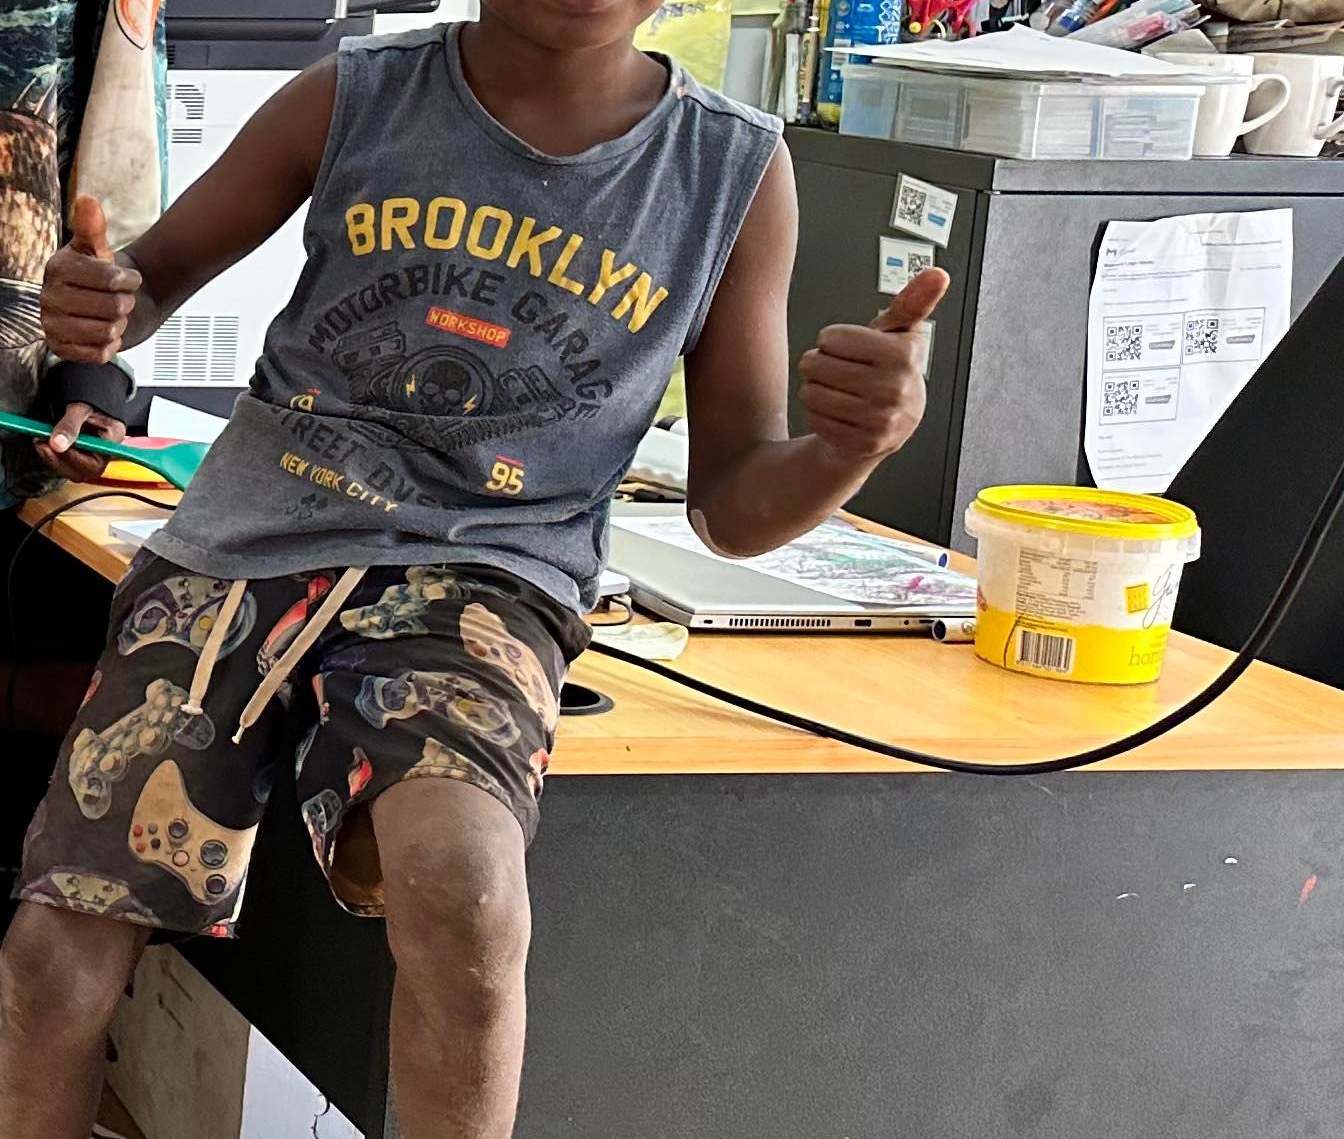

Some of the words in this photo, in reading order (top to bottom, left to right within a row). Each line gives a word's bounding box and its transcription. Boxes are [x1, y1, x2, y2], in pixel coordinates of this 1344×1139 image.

[344, 195, 669, 334] BROOKLYN
[308, 262, 506, 354] MOTORBIKE
[429, 310, 507, 344] WORKSHOP
[279, 452, 308, 478] NEW
[309, 465, 346, 493] YORK
[346, 481, 400, 513] CITY
[485, 461, 525, 496] 95
